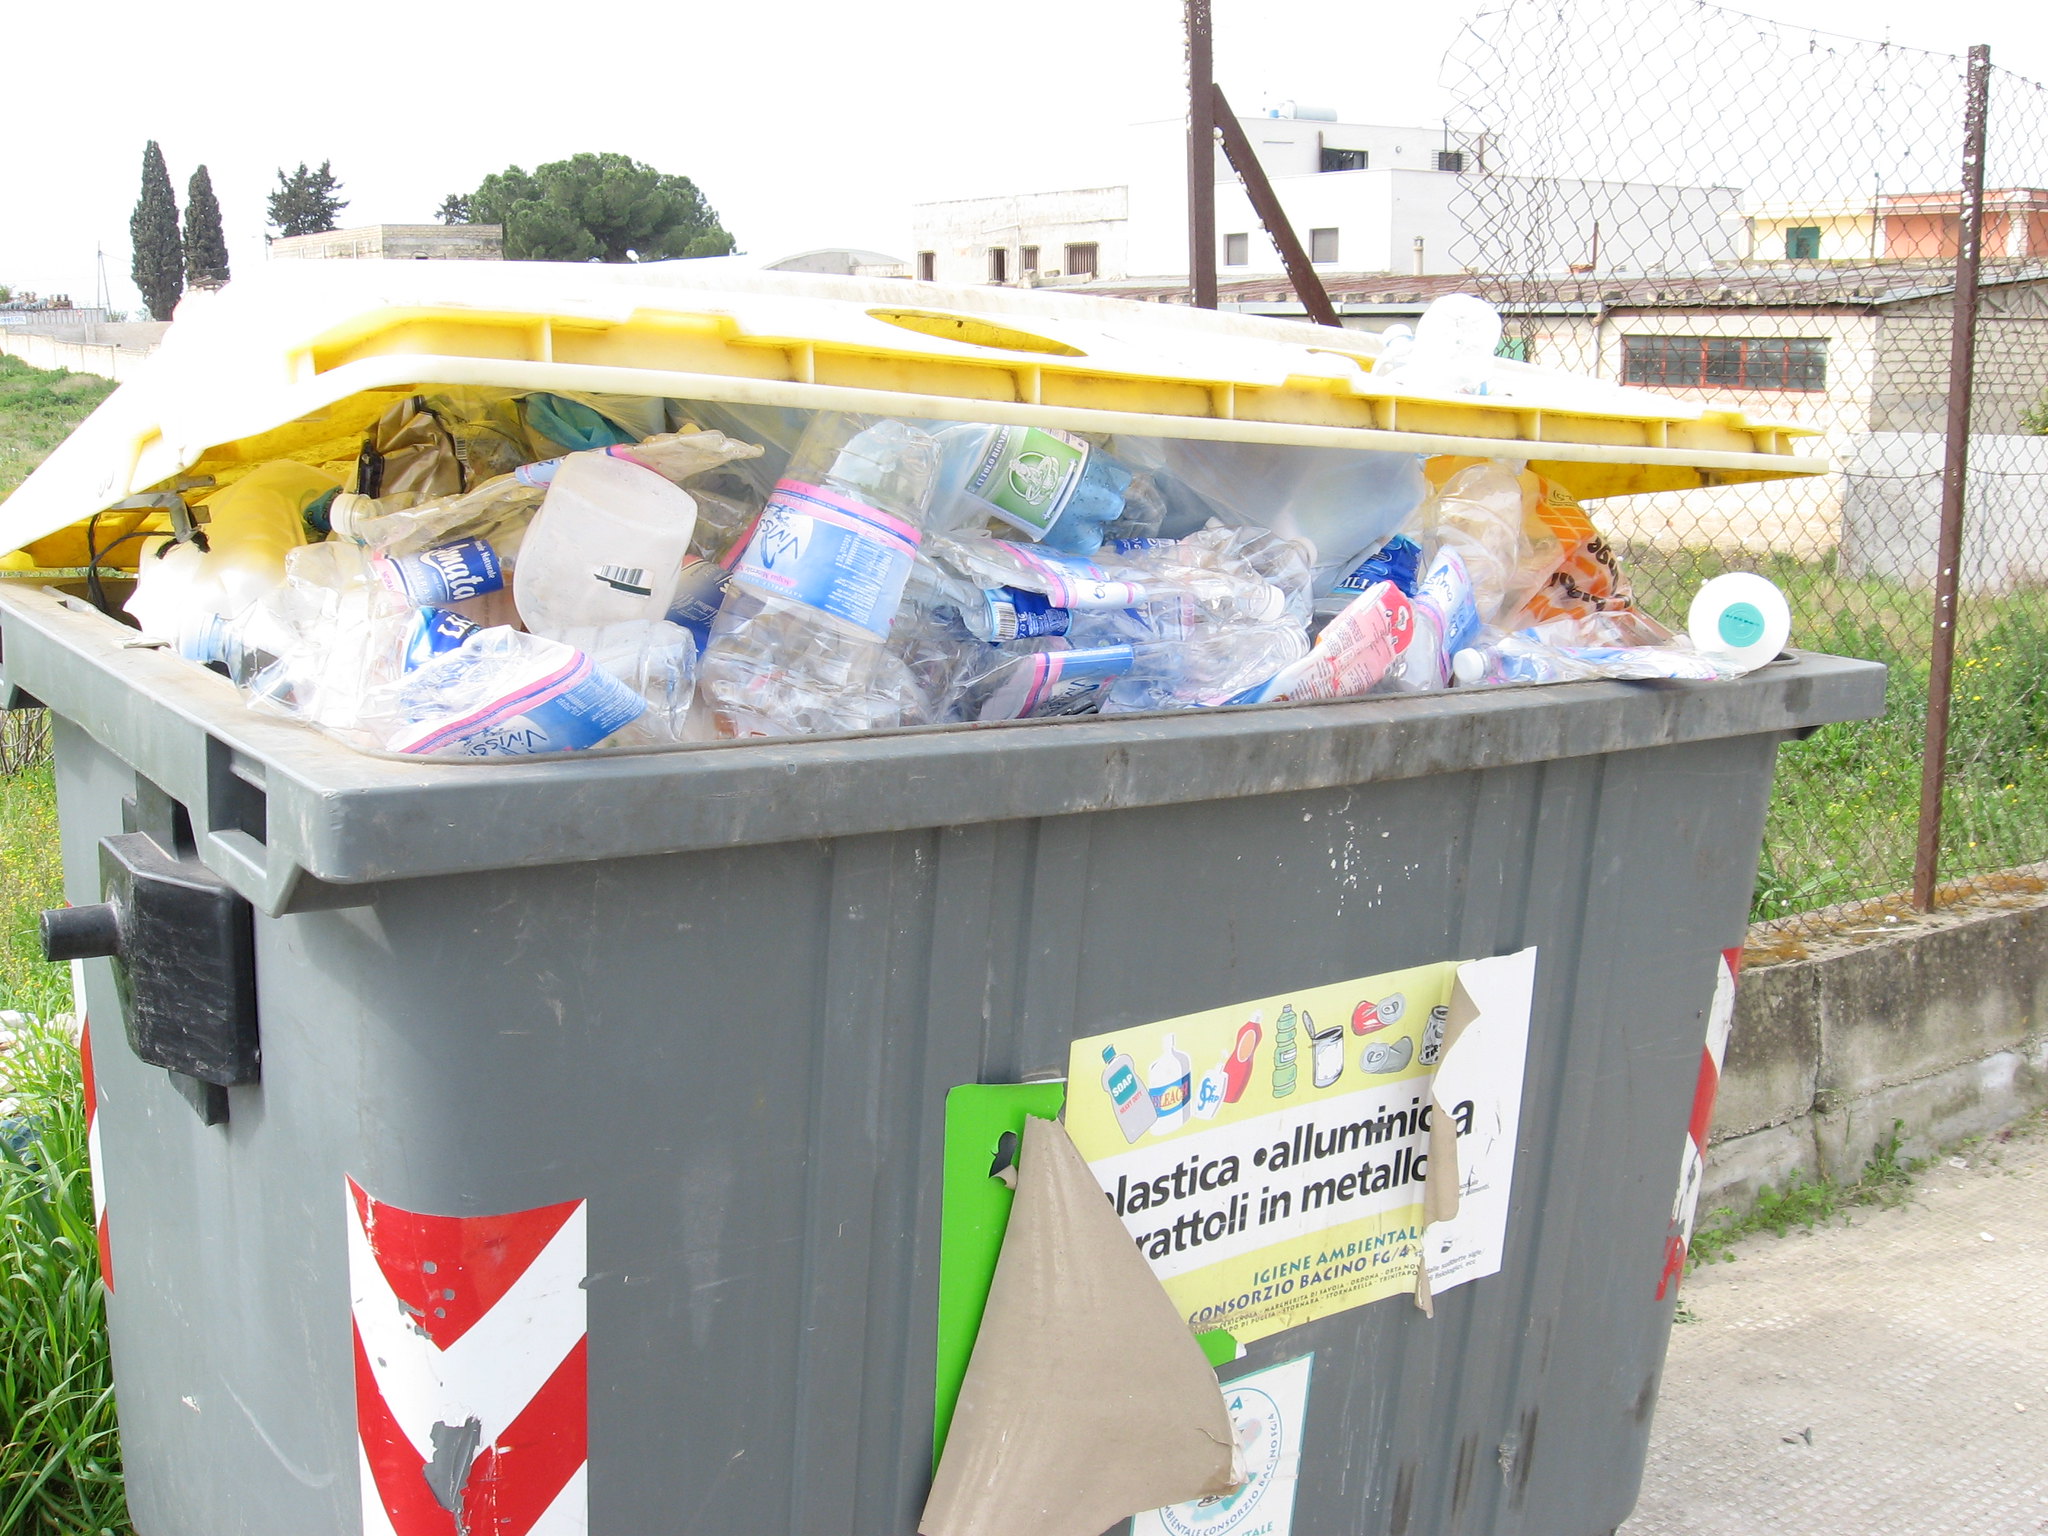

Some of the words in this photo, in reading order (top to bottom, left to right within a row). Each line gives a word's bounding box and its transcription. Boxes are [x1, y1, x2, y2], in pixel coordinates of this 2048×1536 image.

[480, 551, 496, 579] Naturale
[1111, 1073, 1133, 1098] SOAP
[1258, 1186, 1292, 1225] in
[1188, 1279, 1295, 1325] CONSORZIO
[1299, 1257, 1367, 1289] BACINO
[1372, 1244, 1410, 1268] FG/4
[1253, 1255, 1311, 1287] IGIENE
[1264, 1294, 1308, 1312] MARGHERITA
[1311, 1290, 1319, 1298] DI
[1320, 1283, 1345, 1296] SAVOIA
[1351, 1273, 1379, 1285] ORDONA
[1385, 1266, 1402, 1275] ORTA
[1282, 1298, 1319, 1313] STORNARA
[1326, 1282, 1373, 1299] STORNARELLA
[1204, 1490, 1259, 1536] CONSORZIO
